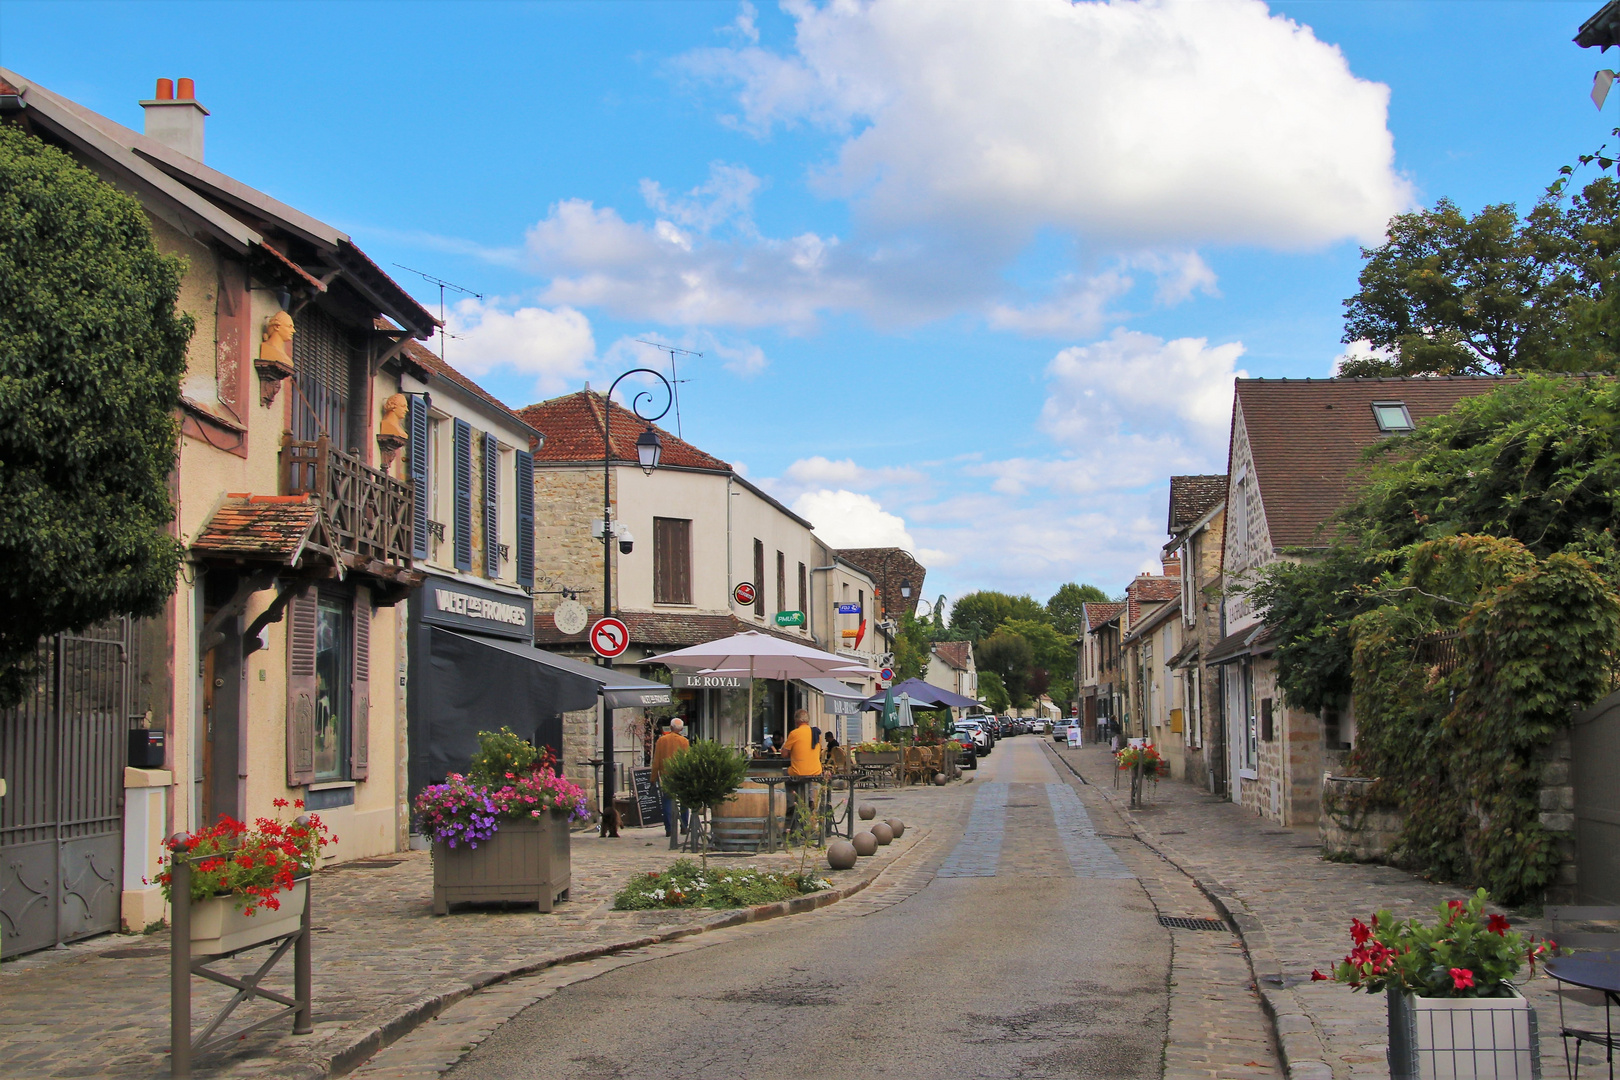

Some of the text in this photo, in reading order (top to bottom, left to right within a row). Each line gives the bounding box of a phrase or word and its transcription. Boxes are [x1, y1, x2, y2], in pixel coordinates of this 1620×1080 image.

[435, 588, 468, 615] VALET
[480, 599, 526, 626] FROMAGES
[687, 676, 741, 687] LE ROYAL
